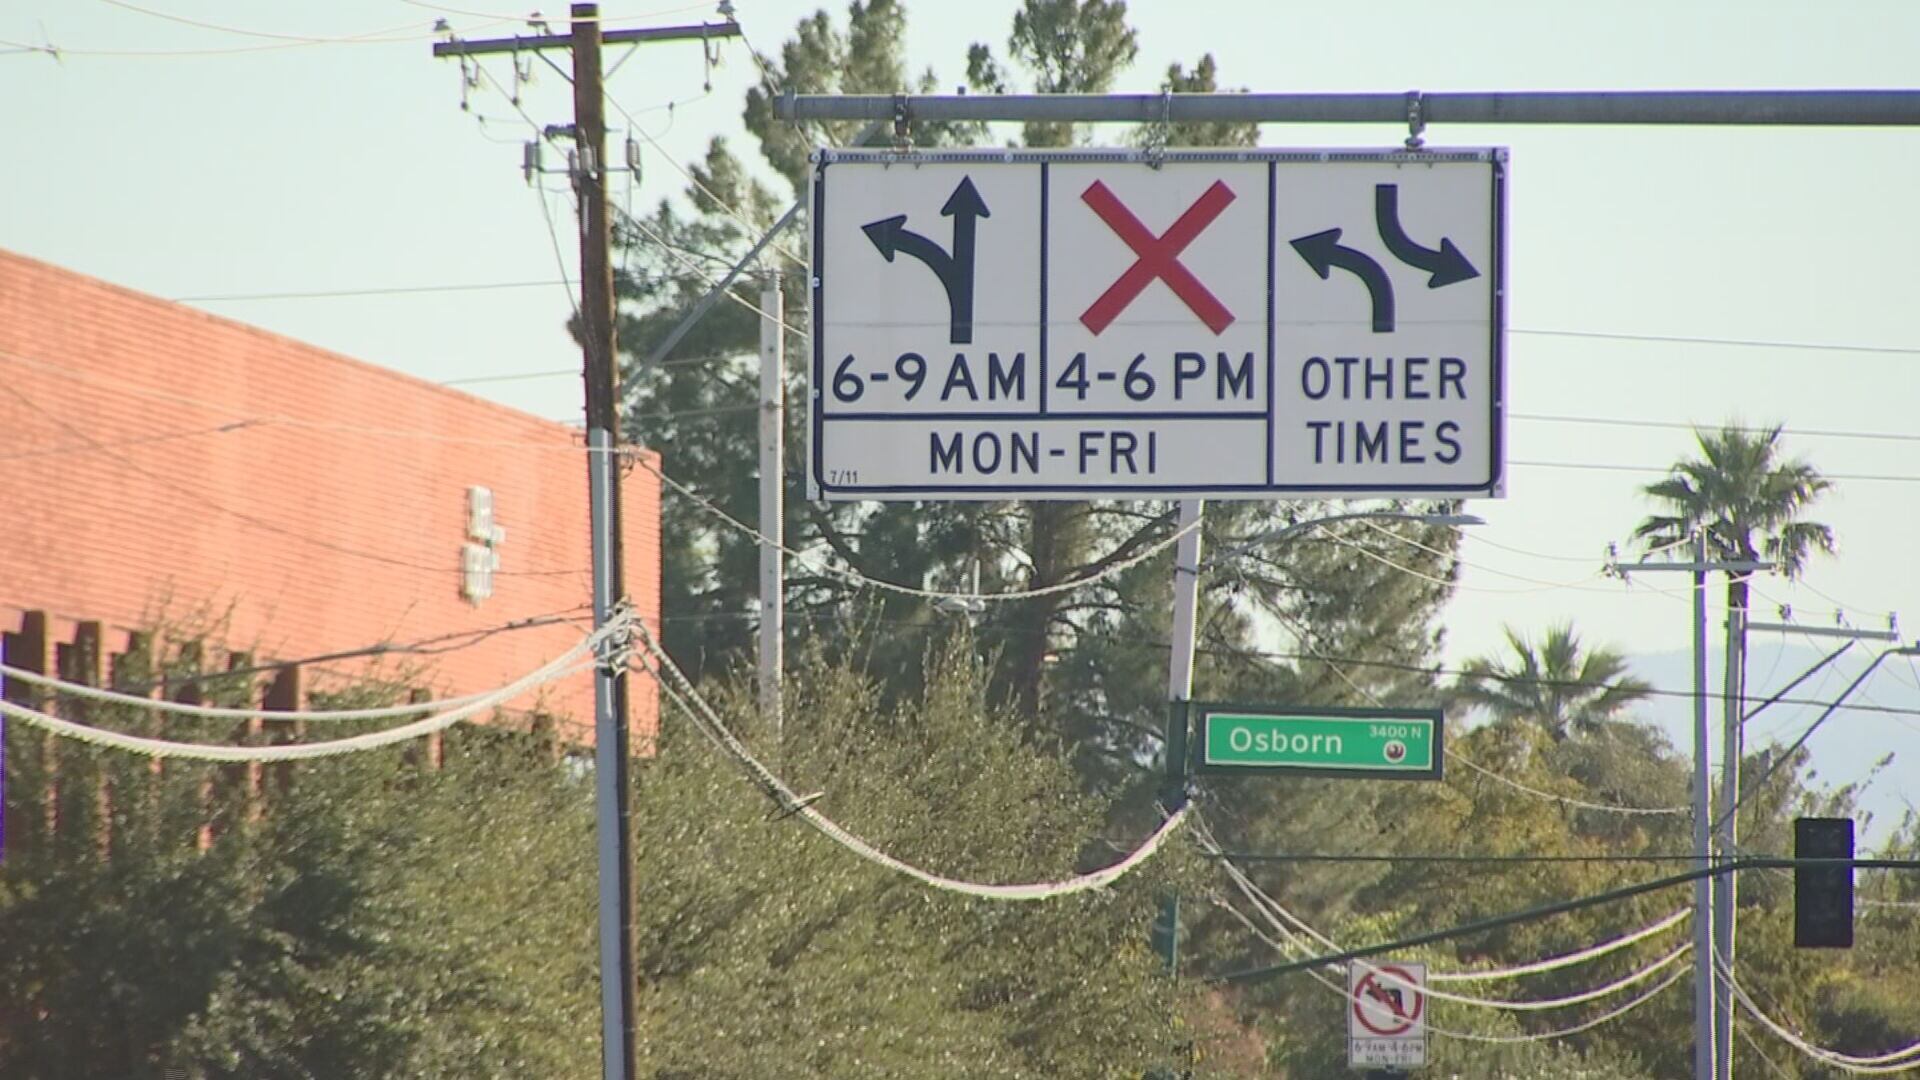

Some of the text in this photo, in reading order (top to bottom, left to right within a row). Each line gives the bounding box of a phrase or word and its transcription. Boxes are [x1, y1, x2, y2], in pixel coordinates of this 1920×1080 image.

[1055, 352, 1255, 402] 4-6 PM
[1302, 357, 1467, 400] OTHER
[930, 431, 1156, 474] MON-FRI
[1306, 420, 1462, 464] TIMES
[830, 470, 857, 485] 7/11
[1229, 726, 1343, 754] Osborn
[1369, 724, 1421, 739] 3400 N
